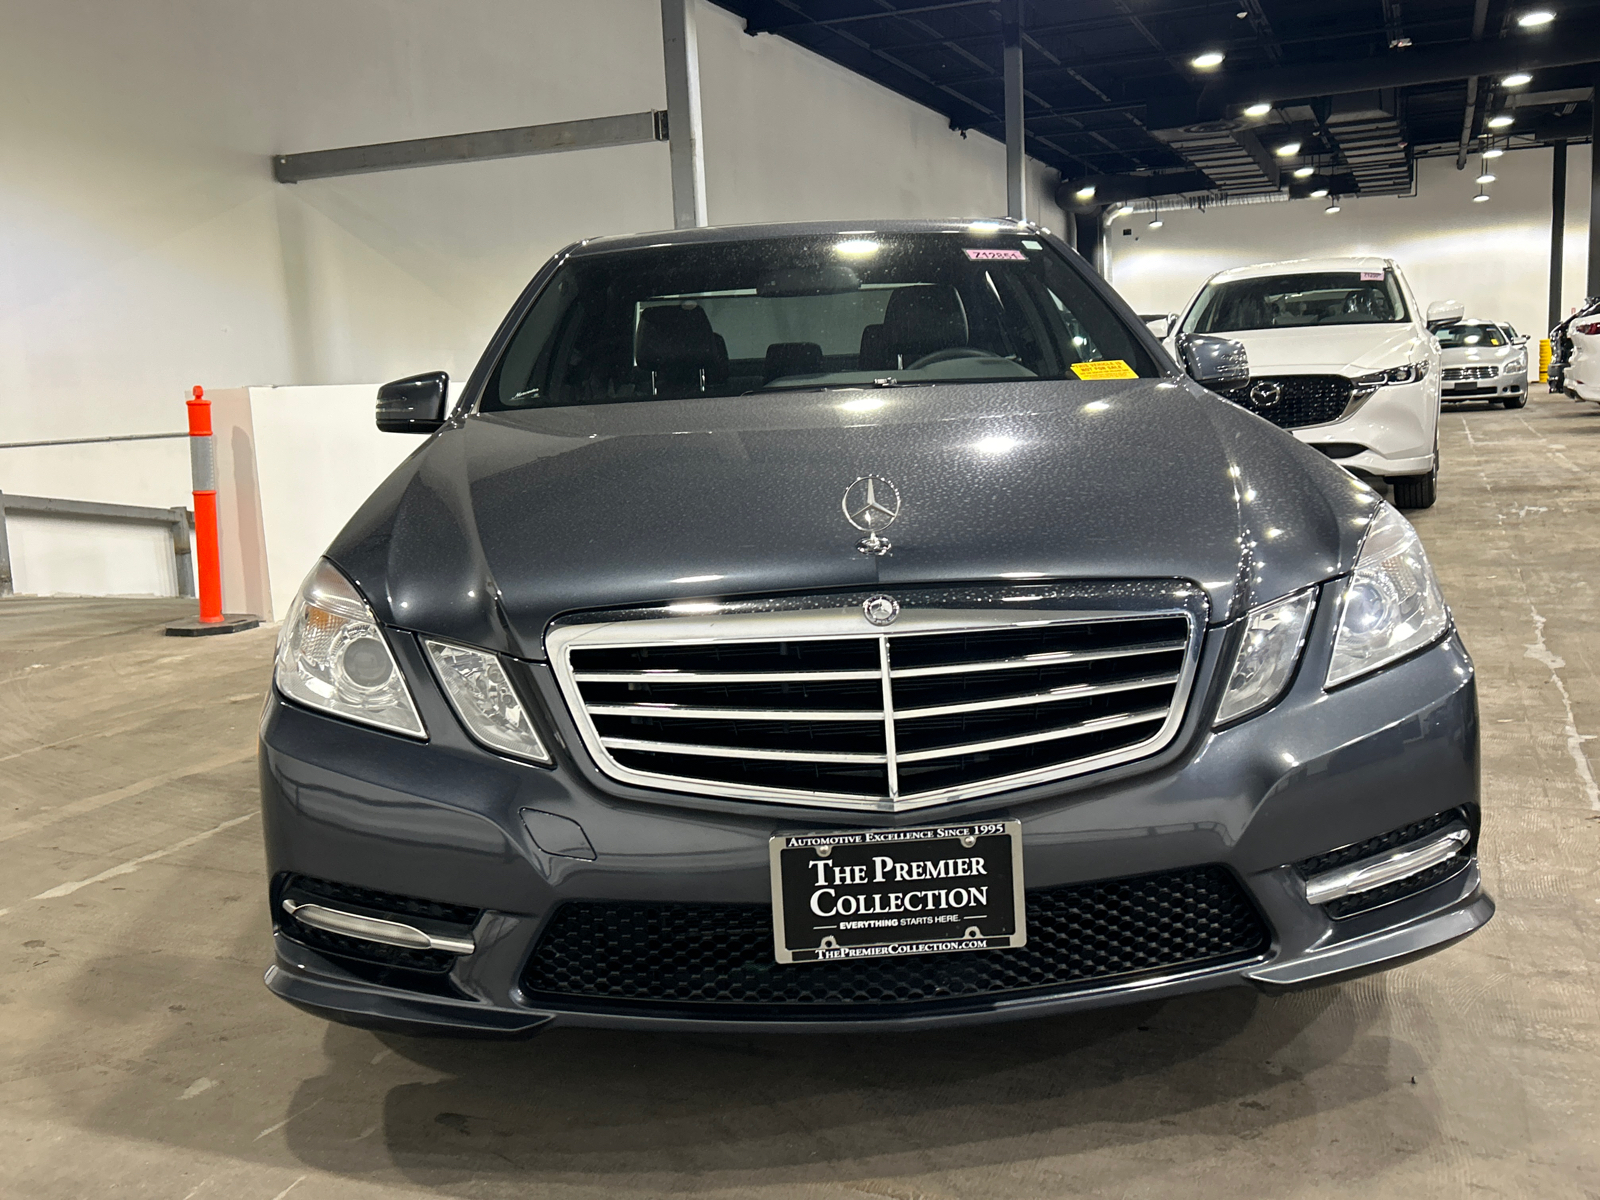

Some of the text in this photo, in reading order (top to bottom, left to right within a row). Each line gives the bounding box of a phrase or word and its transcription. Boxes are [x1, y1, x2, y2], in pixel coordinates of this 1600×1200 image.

[788, 824, 1004, 847] AUTOMOTIVE EXCELLENCE SINCE 1995
[808, 856, 988, 886] THE PREMIER
[810, 886, 988, 917] COLLECTION
[839, 914, 961, 930] EVERYTHING STARTS HERE.
[815, 940, 987, 959] THEPREMIERCOLLECTION.COM
